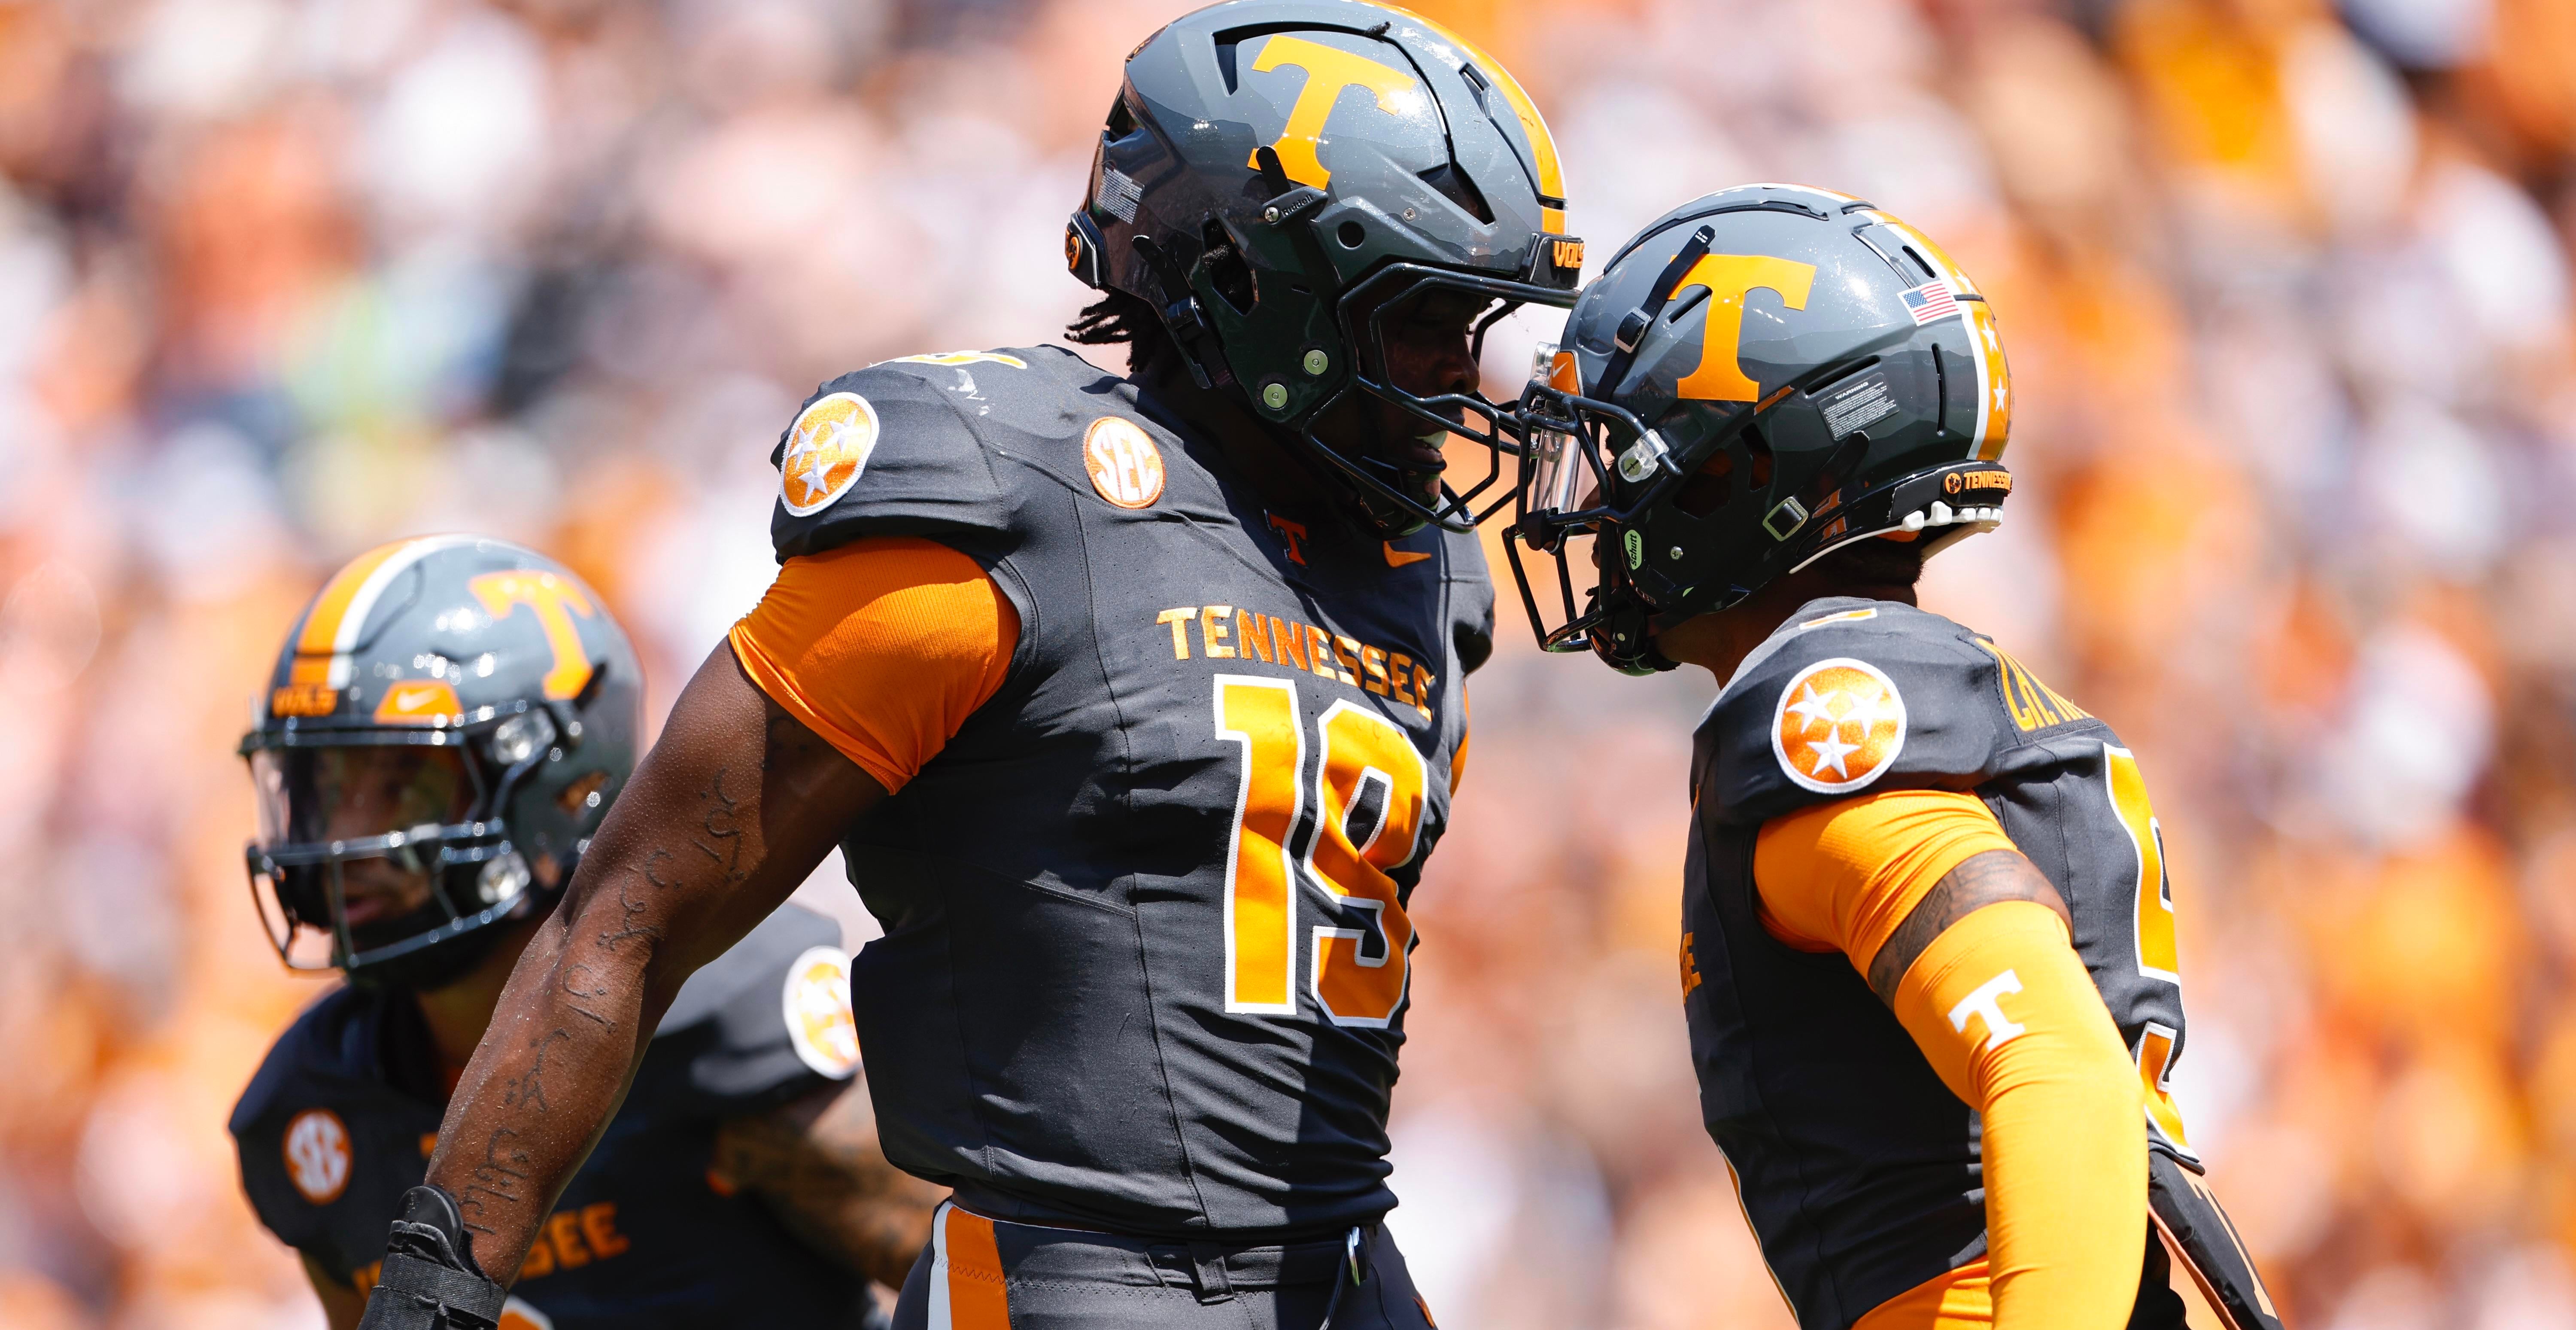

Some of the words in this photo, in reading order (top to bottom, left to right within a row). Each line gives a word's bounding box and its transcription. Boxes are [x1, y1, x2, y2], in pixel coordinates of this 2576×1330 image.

[1247, 34, 1416, 190] T
[1667, 253, 1817, 402] T
[1835, 381, 1869, 400] WARNING
[1090, 423, 1160, 502] SEC
[1629, 533, 1637, 566] schutt
[1156, 606, 1436, 722] TENNESSEE
[1214, 673, 1430, 1029] 19
[1947, 968, 2024, 1051] T
